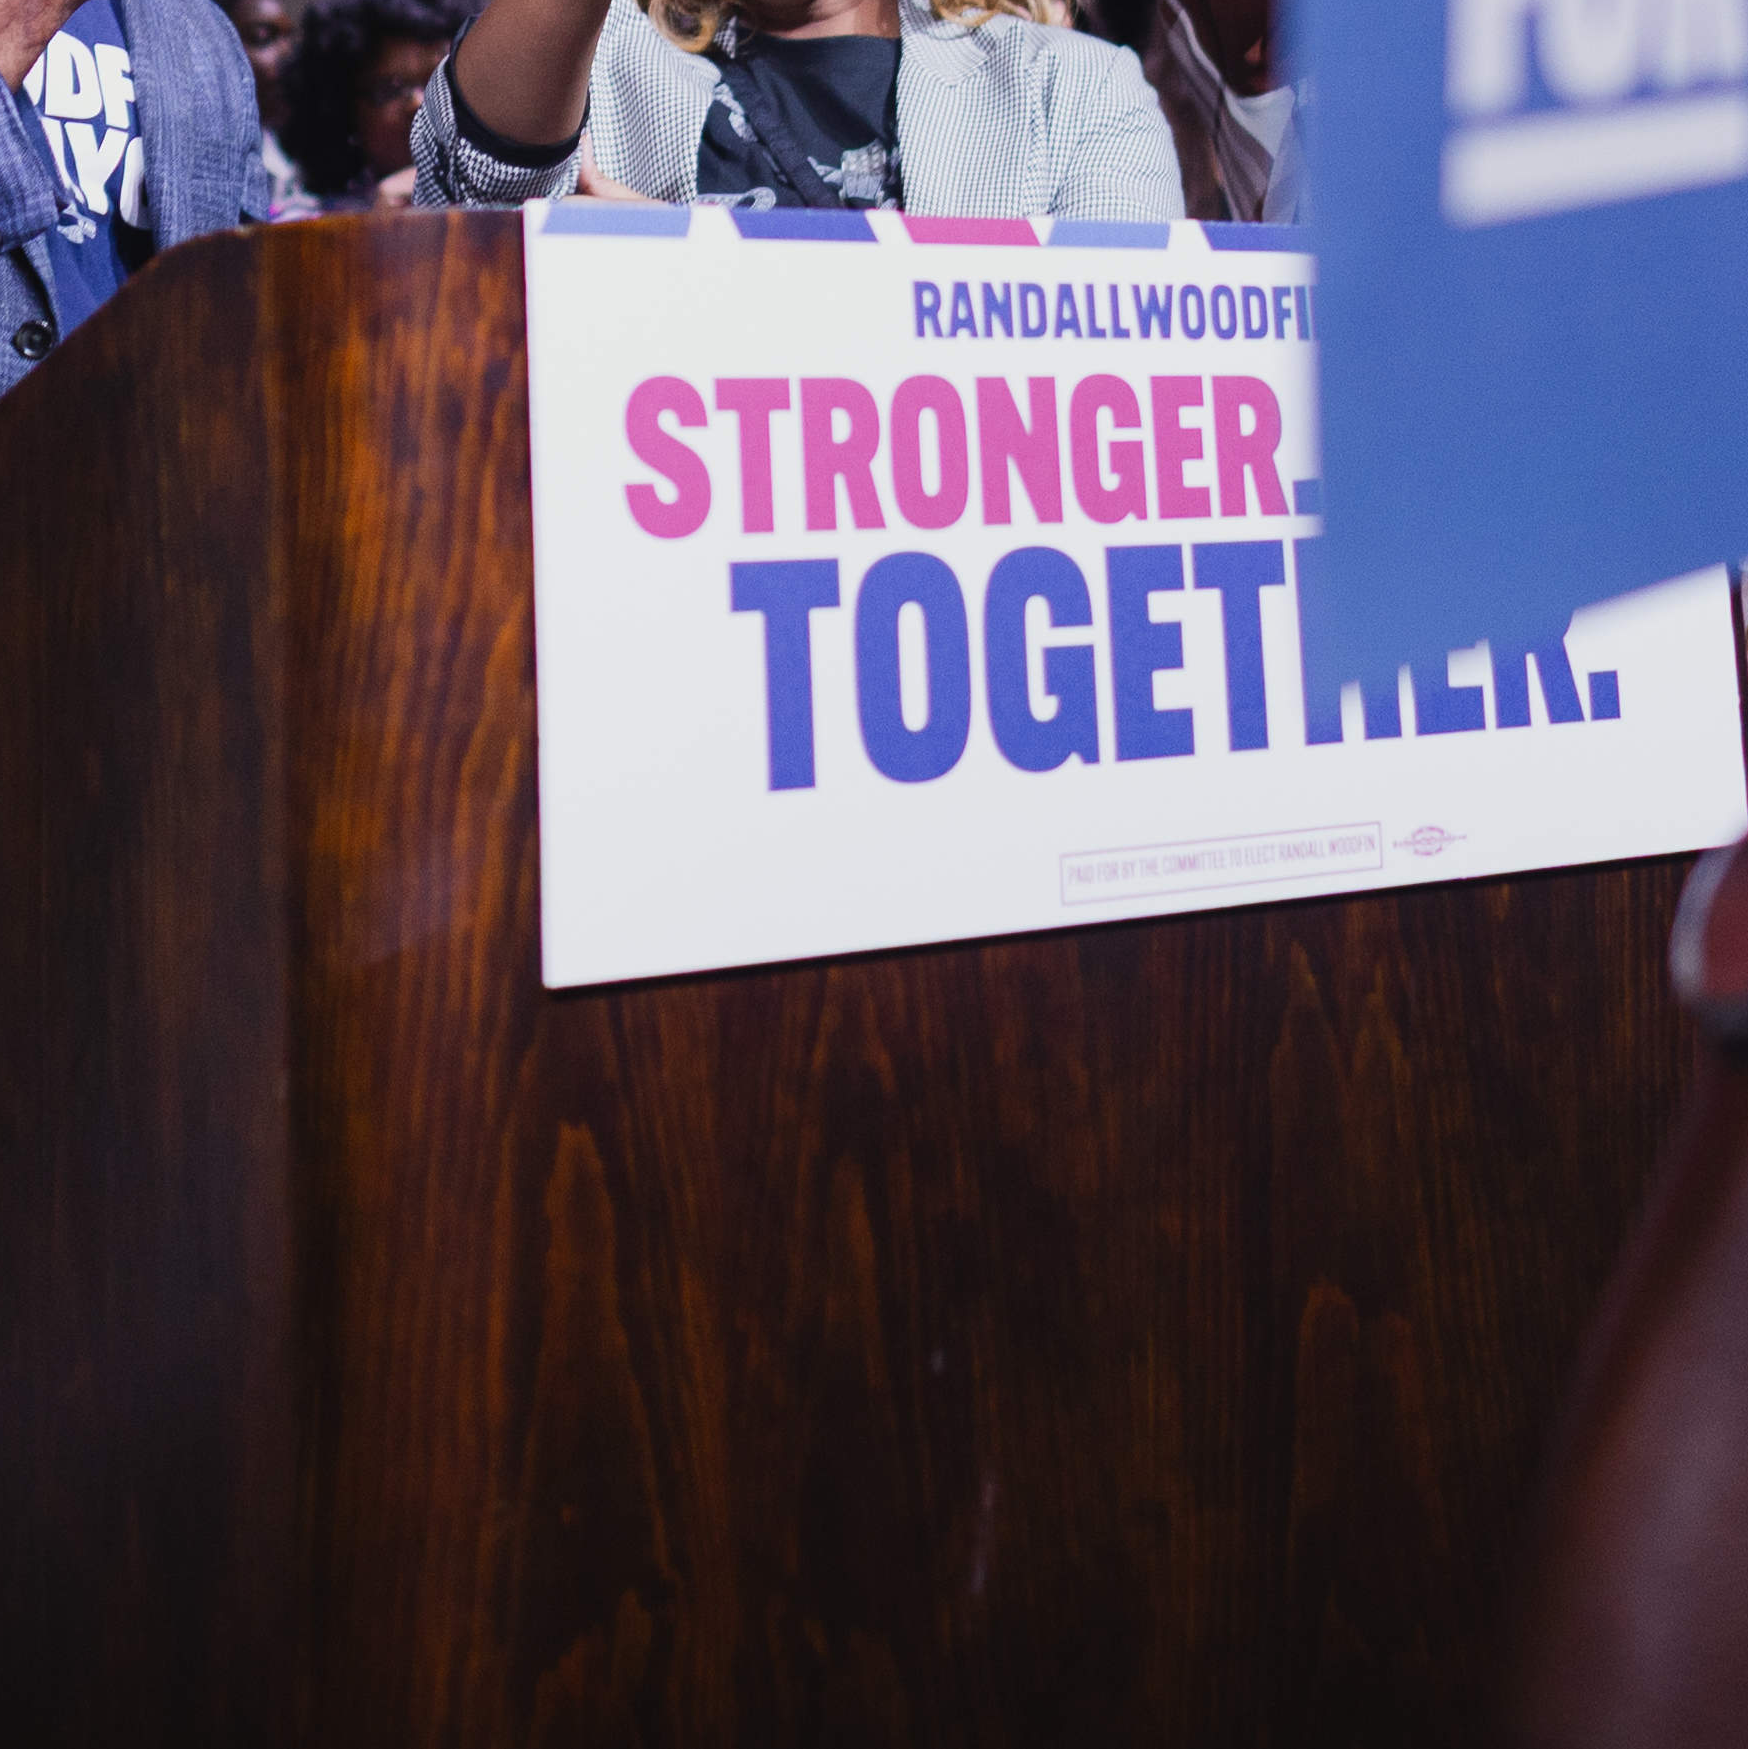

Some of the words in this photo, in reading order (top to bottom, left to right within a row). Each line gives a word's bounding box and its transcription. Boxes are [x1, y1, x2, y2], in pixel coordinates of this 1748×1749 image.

[1068, 862, 1094, 885] PAID
[1097, 859, 1119, 882] FOR
[1121, 858, 1136, 880] BY
[1139, 854, 1160, 877] THE
[1162, 847, 1227, 875] COMMITTEE
[1230, 847, 1243, 868] TO
[1245, 842, 1276, 867] ELECT
[1278, 837, 1326, 864] RANDALL
[1327, 833, 1376, 860] WOODFIN
